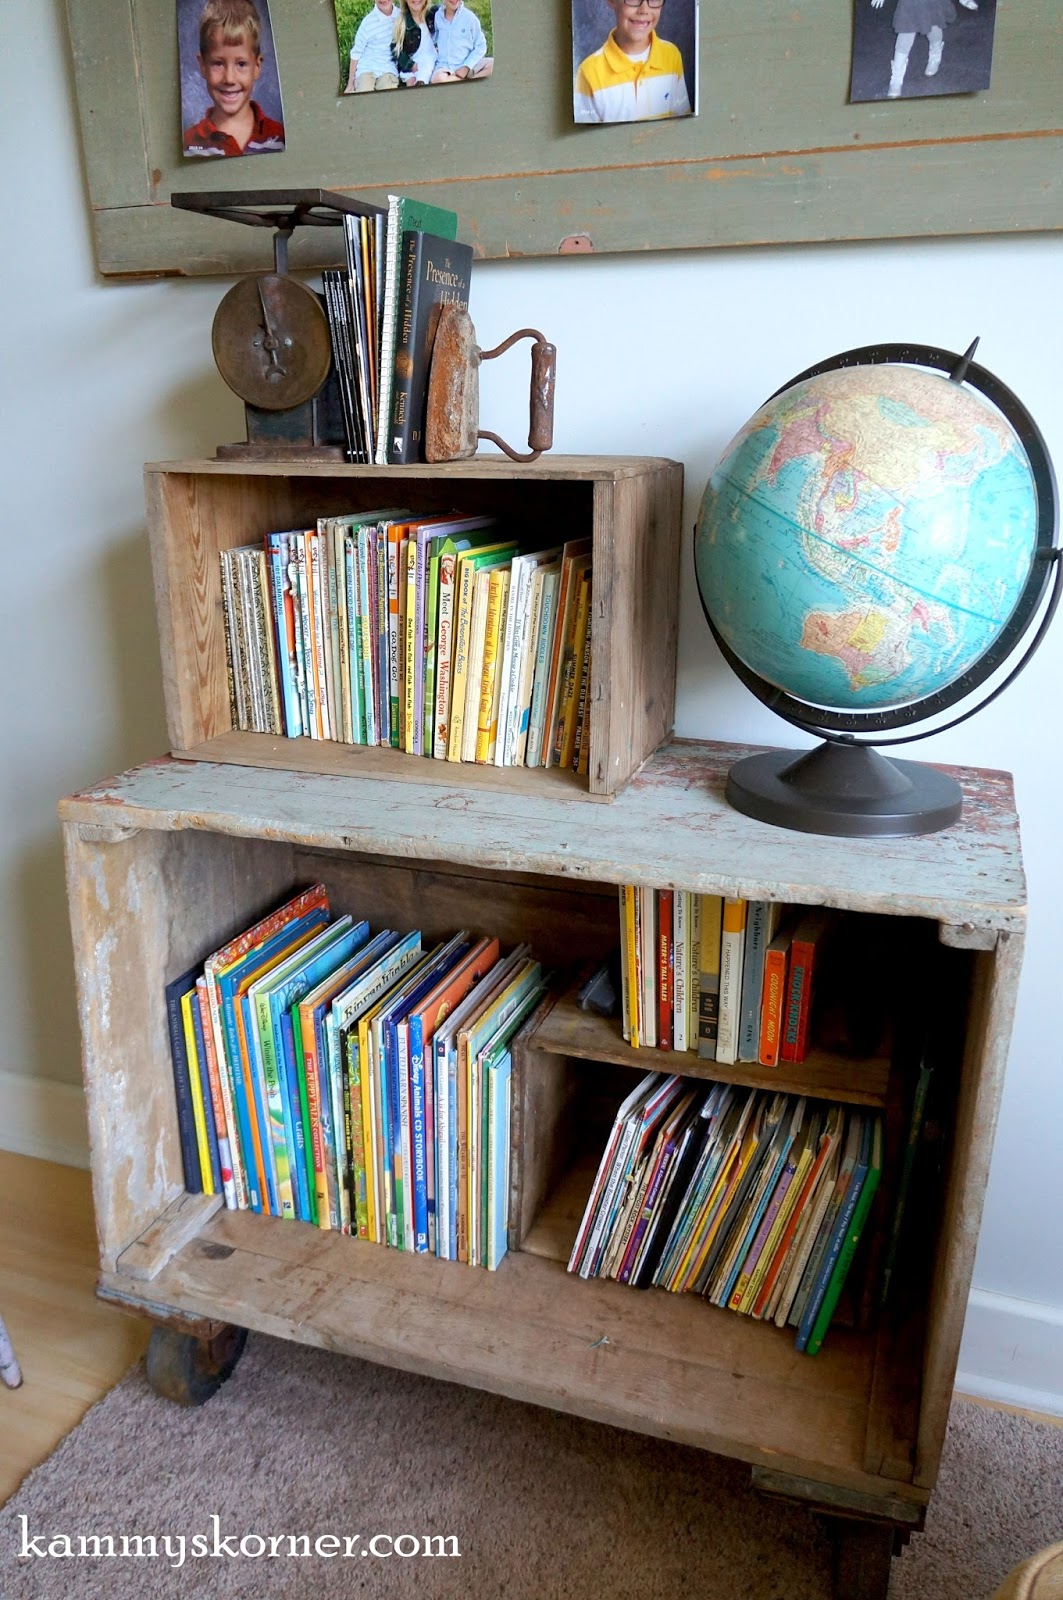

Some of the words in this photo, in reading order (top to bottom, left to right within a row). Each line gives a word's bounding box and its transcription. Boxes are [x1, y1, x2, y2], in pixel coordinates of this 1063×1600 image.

[408, 240, 416, 253] The
[406, 254, 417, 295] Presence
[426, 261, 459, 288] Presence
[440, 290, 468, 310] Hidden
[402, 308, 413, 344] Hidden
[398, 392, 408, 425] Kennedy
[275, 576, 284, 616] DALMATIANS
[442, 592, 451, 615] Meet
[488, 583, 499, 605] Further
[460, 607, 469, 618] The
[486, 609, 497, 639] Adventures
[542, 594, 552, 636] TOUCHDOWN
[302, 615, 310, 637] WOCKET
[362, 615, 371, 660] POPCORN
[458, 618, 468, 653] Berenstain
[514, 625, 522, 636] You
[390, 631, 398, 645] Go,
[439, 620, 451, 656] George
[484, 650, 494, 659] the
[511, 652, 519, 670] Mouse
[538, 638, 547, 664] RIDDLES
[583, 640, 591, 664] PARSON
[391, 666, 399, 682] Go!
[456, 654, 466, 674] Bears
[482, 661, 493, 678] Sugar
[570, 654, 578, 680] SUMMER
[437, 660, 450, 716] Washington
[481, 680, 491, 696] Creek
[509, 674, 517, 693] Cookie
[391, 703, 399, 732] Eastman
[480, 699, 490, 713] Gang
[577, 701, 585, 718] WEST
[574, 726, 582, 749] PALMER
[752, 907, 763, 951] Neighbors
[675, 941, 684, 976] Nature's
[691, 941, 700, 975] Nature's
[209, 987, 217, 1009] WALDO
[676, 979, 685, 1014] Children
[691, 977, 700, 1013] Children
[768, 973, 779, 1018] GOODNIGHT
[787, 966, 803, 1044] KNOCK-KNOCKS
[229, 1027, 237, 1043] Tales
[746, 1025, 754, 1043] GINN
[767, 1019, 777, 1044] MOON
[171, 1014, 180, 1041] ANIMALS
[178, 1076, 185, 1084] BY
[263, 1040, 274, 1066] Winnie
[232, 1054, 242, 1086] BEDTIME
[266, 1066, 275, 1079] the
[399, 1056, 406, 1067] TO
[410, 1053, 425, 1085] Disney
[220, 1066, 228, 1088] MARTIN
[307, 1072, 317, 1100] PUPPY
[268, 1080, 278, 1099] Pooh
[213, 1103, 220, 1111] TO
[223, 1088, 232, 1120] HANDFORD
[413, 1085, 422, 1118] Animals
[214, 1112, 223, 1134] SCHOOL
[310, 1102, 319, 1128] TALES
[415, 1120, 422, 1131] CD
[438, 1111, 446, 1120] for
[295, 1121, 305, 1149] Crafts
[438, 1120, 447, 1143] Abigail
[313, 1128, 322, 1168] COLLECTION
[415, 1133, 424, 1182] STORYBOOK
[612, 1162, 623, 1179] When
[609, 1177, 618, 1188] the
[641, 1182, 649, 1193] THE
[602, 1187, 615, 1211] Rooster
[634, 1192, 645, 1210] GHOST
[595, 1210, 607, 1231] Crowed
[629, 1209, 639, 1224] ROCK
[621, 1224, 634, 1246] MYSTERY
